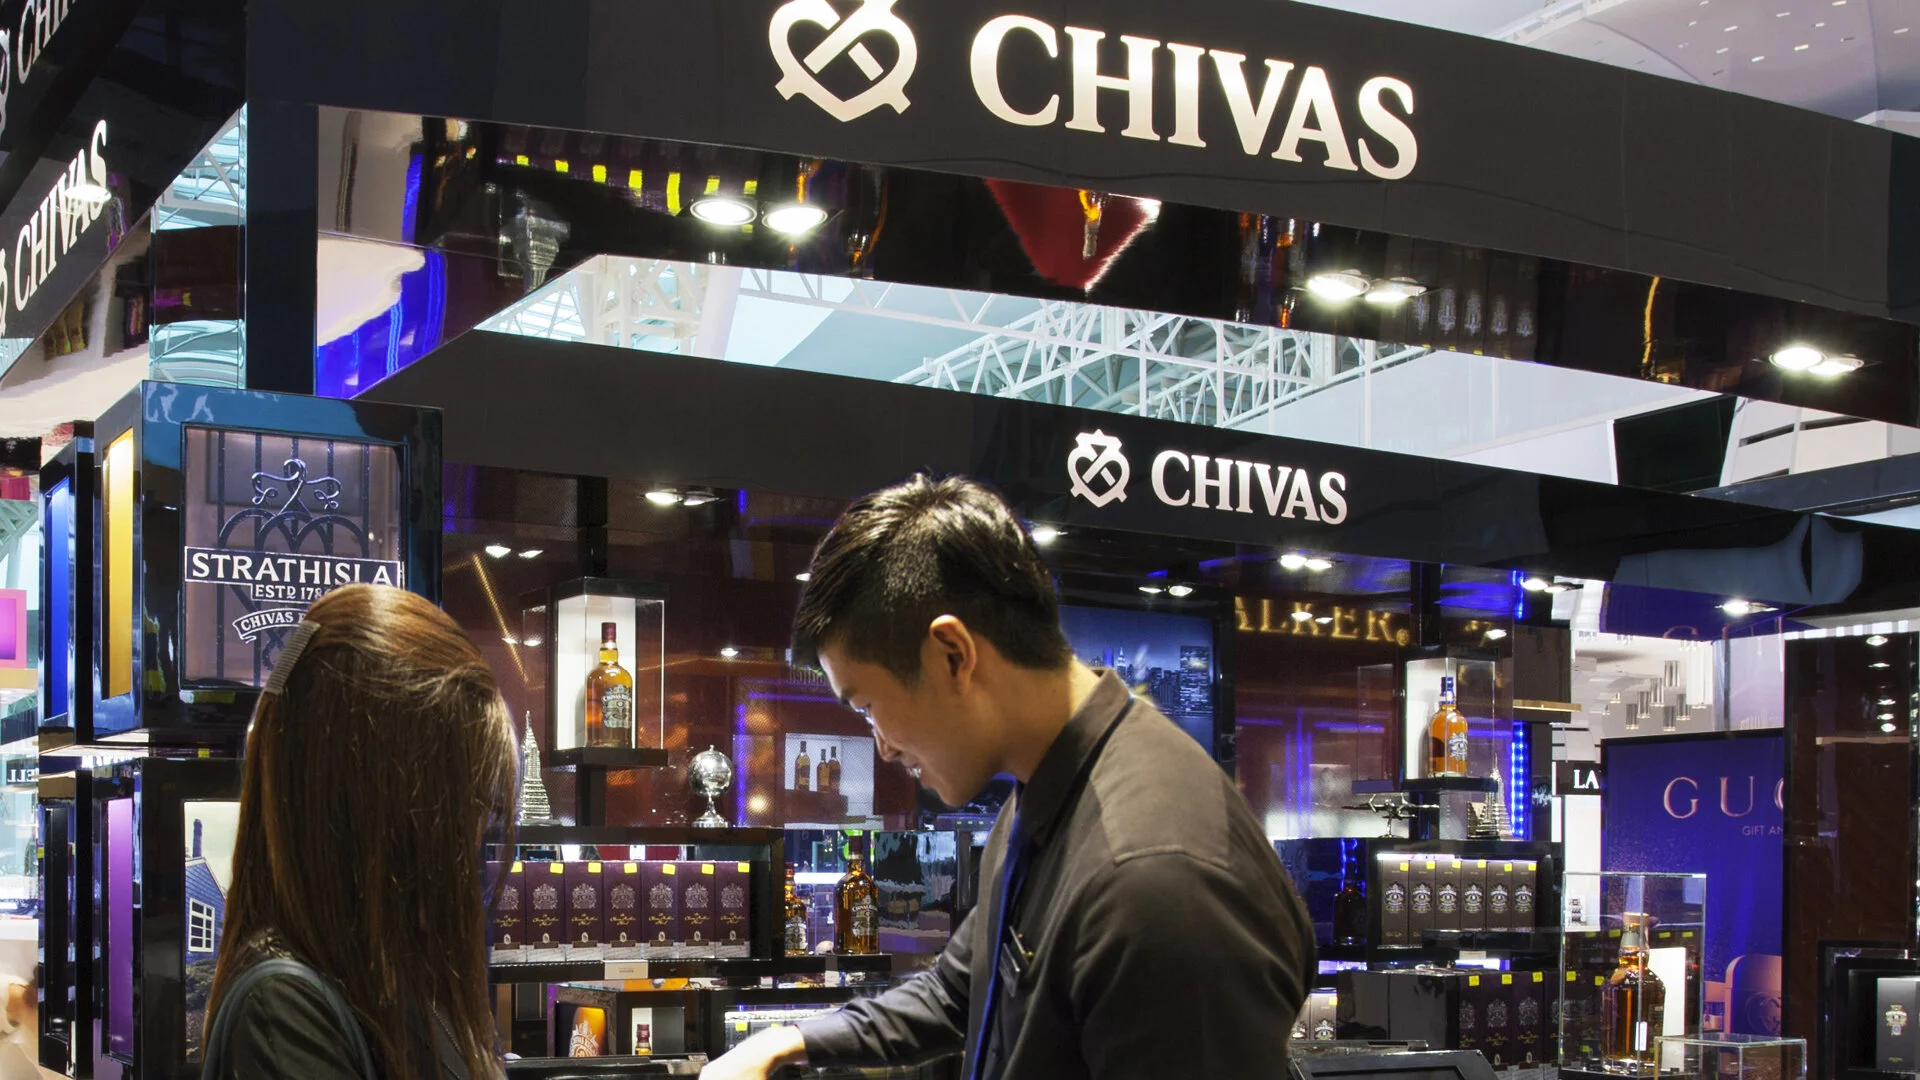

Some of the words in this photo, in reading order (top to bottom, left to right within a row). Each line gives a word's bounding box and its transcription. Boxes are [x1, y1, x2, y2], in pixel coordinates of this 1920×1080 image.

[969, 14, 1418, 180] CHIVAS
[15, 119, 107, 312] CHIVAS
[1151, 450, 1348, 525] CHIVAS
[301, 587, 331, 600] 178
[240, 611, 294, 631] CHIVAS
[1742, 825, 1765, 836] GIFT
